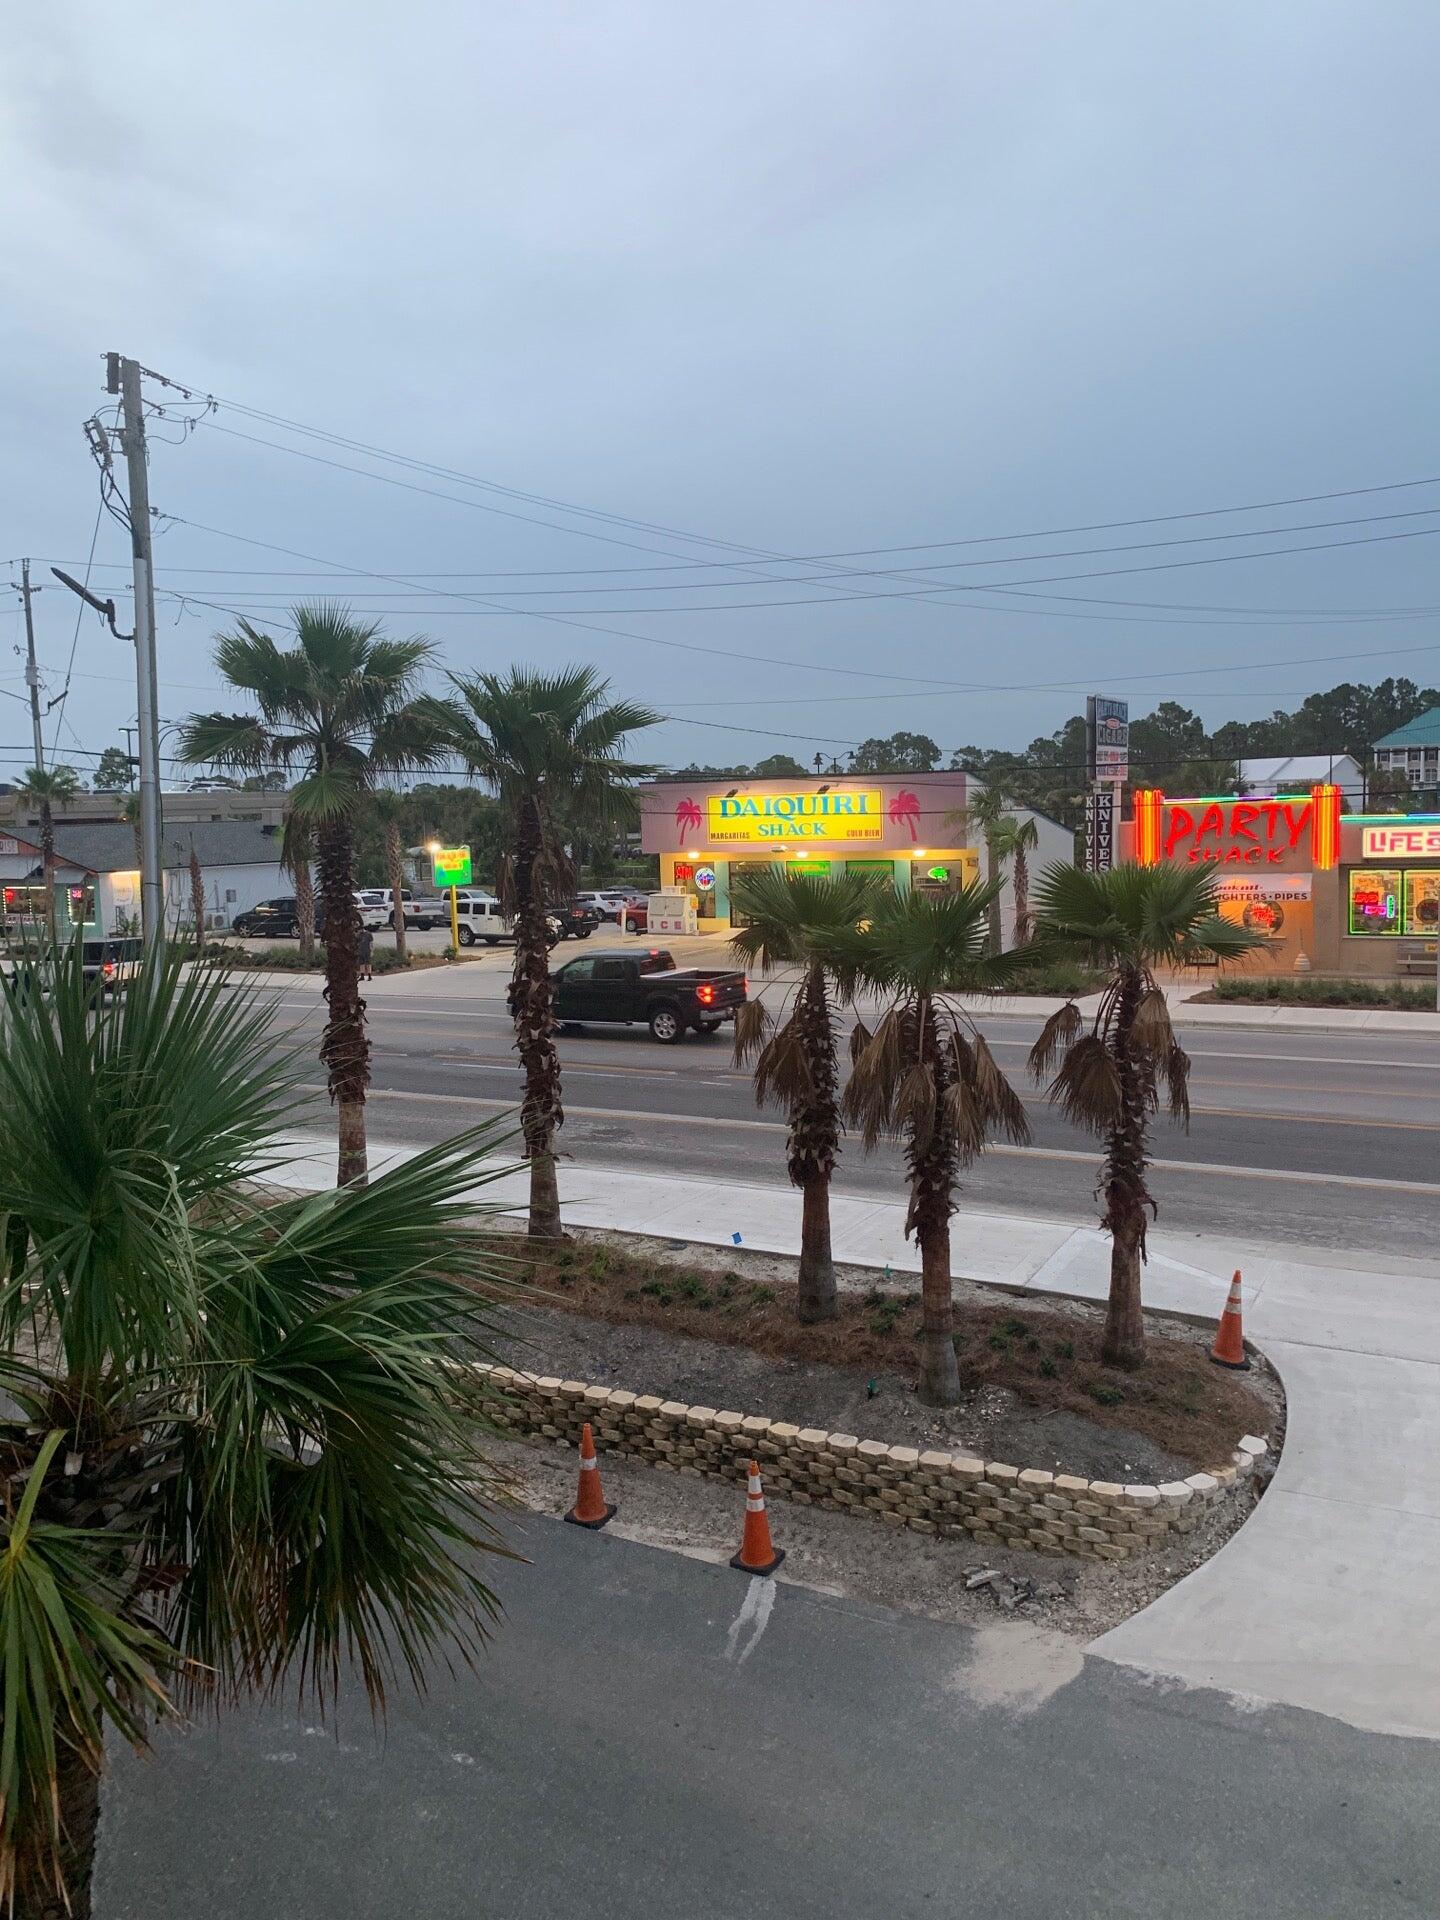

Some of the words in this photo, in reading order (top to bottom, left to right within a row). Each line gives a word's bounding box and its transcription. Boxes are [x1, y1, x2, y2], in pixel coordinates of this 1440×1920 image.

[719, 794, 868, 820] DAIQUIRI
[710, 831, 751, 840] MARGARITAS
[757, 822, 827, 837] SHACK
[1085, 796, 1094, 872] KNIVES
[1098, 795, 1111, 872] KNIVES
[1164, 803, 1313, 859] PARTY
[1186, 845, 1284, 865] SHACK
[1274, 892, 1308, 900] PIPES
[651, 920, 682, 930] ICE
